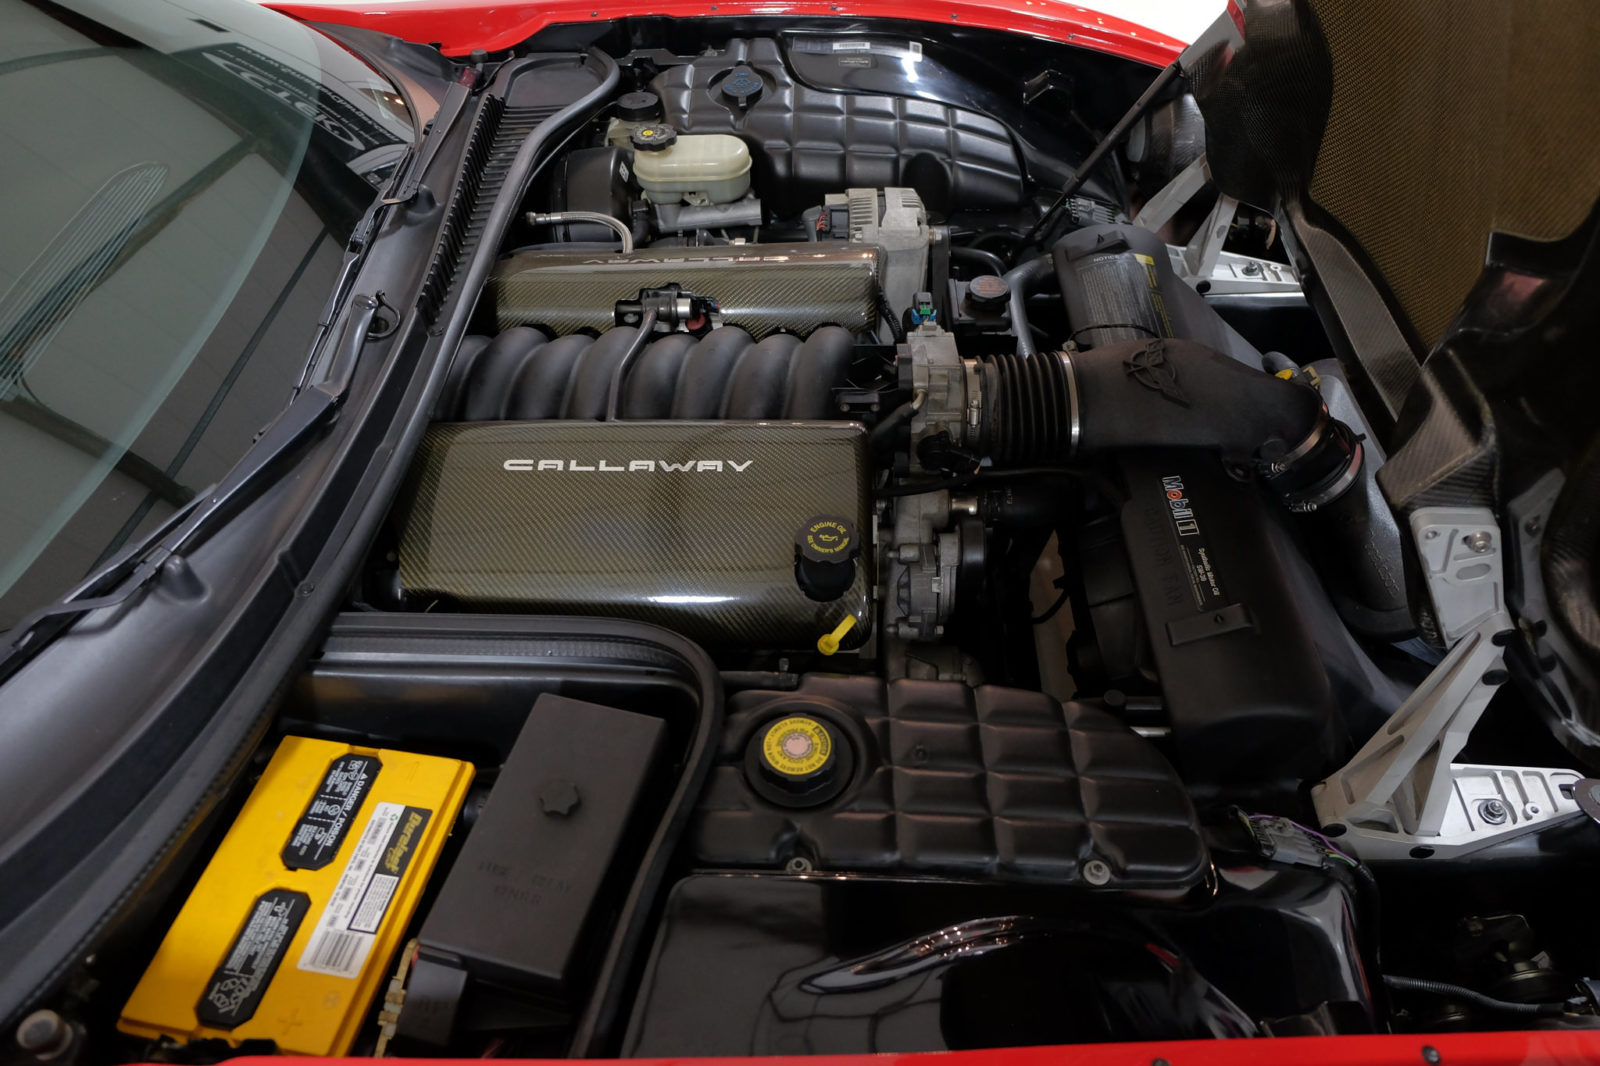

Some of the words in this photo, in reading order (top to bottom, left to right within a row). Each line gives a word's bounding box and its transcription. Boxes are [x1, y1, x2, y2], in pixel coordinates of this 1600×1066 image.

[503, 460, 753, 472] CALLAWAY
[1161, 475, 1193, 519] Mobil
[810, 521, 837, 533] ENGINE
[837, 524, 847, 534] OIL
[343, 780, 365, 813] DANGER
[325, 817, 346, 847] POISON
